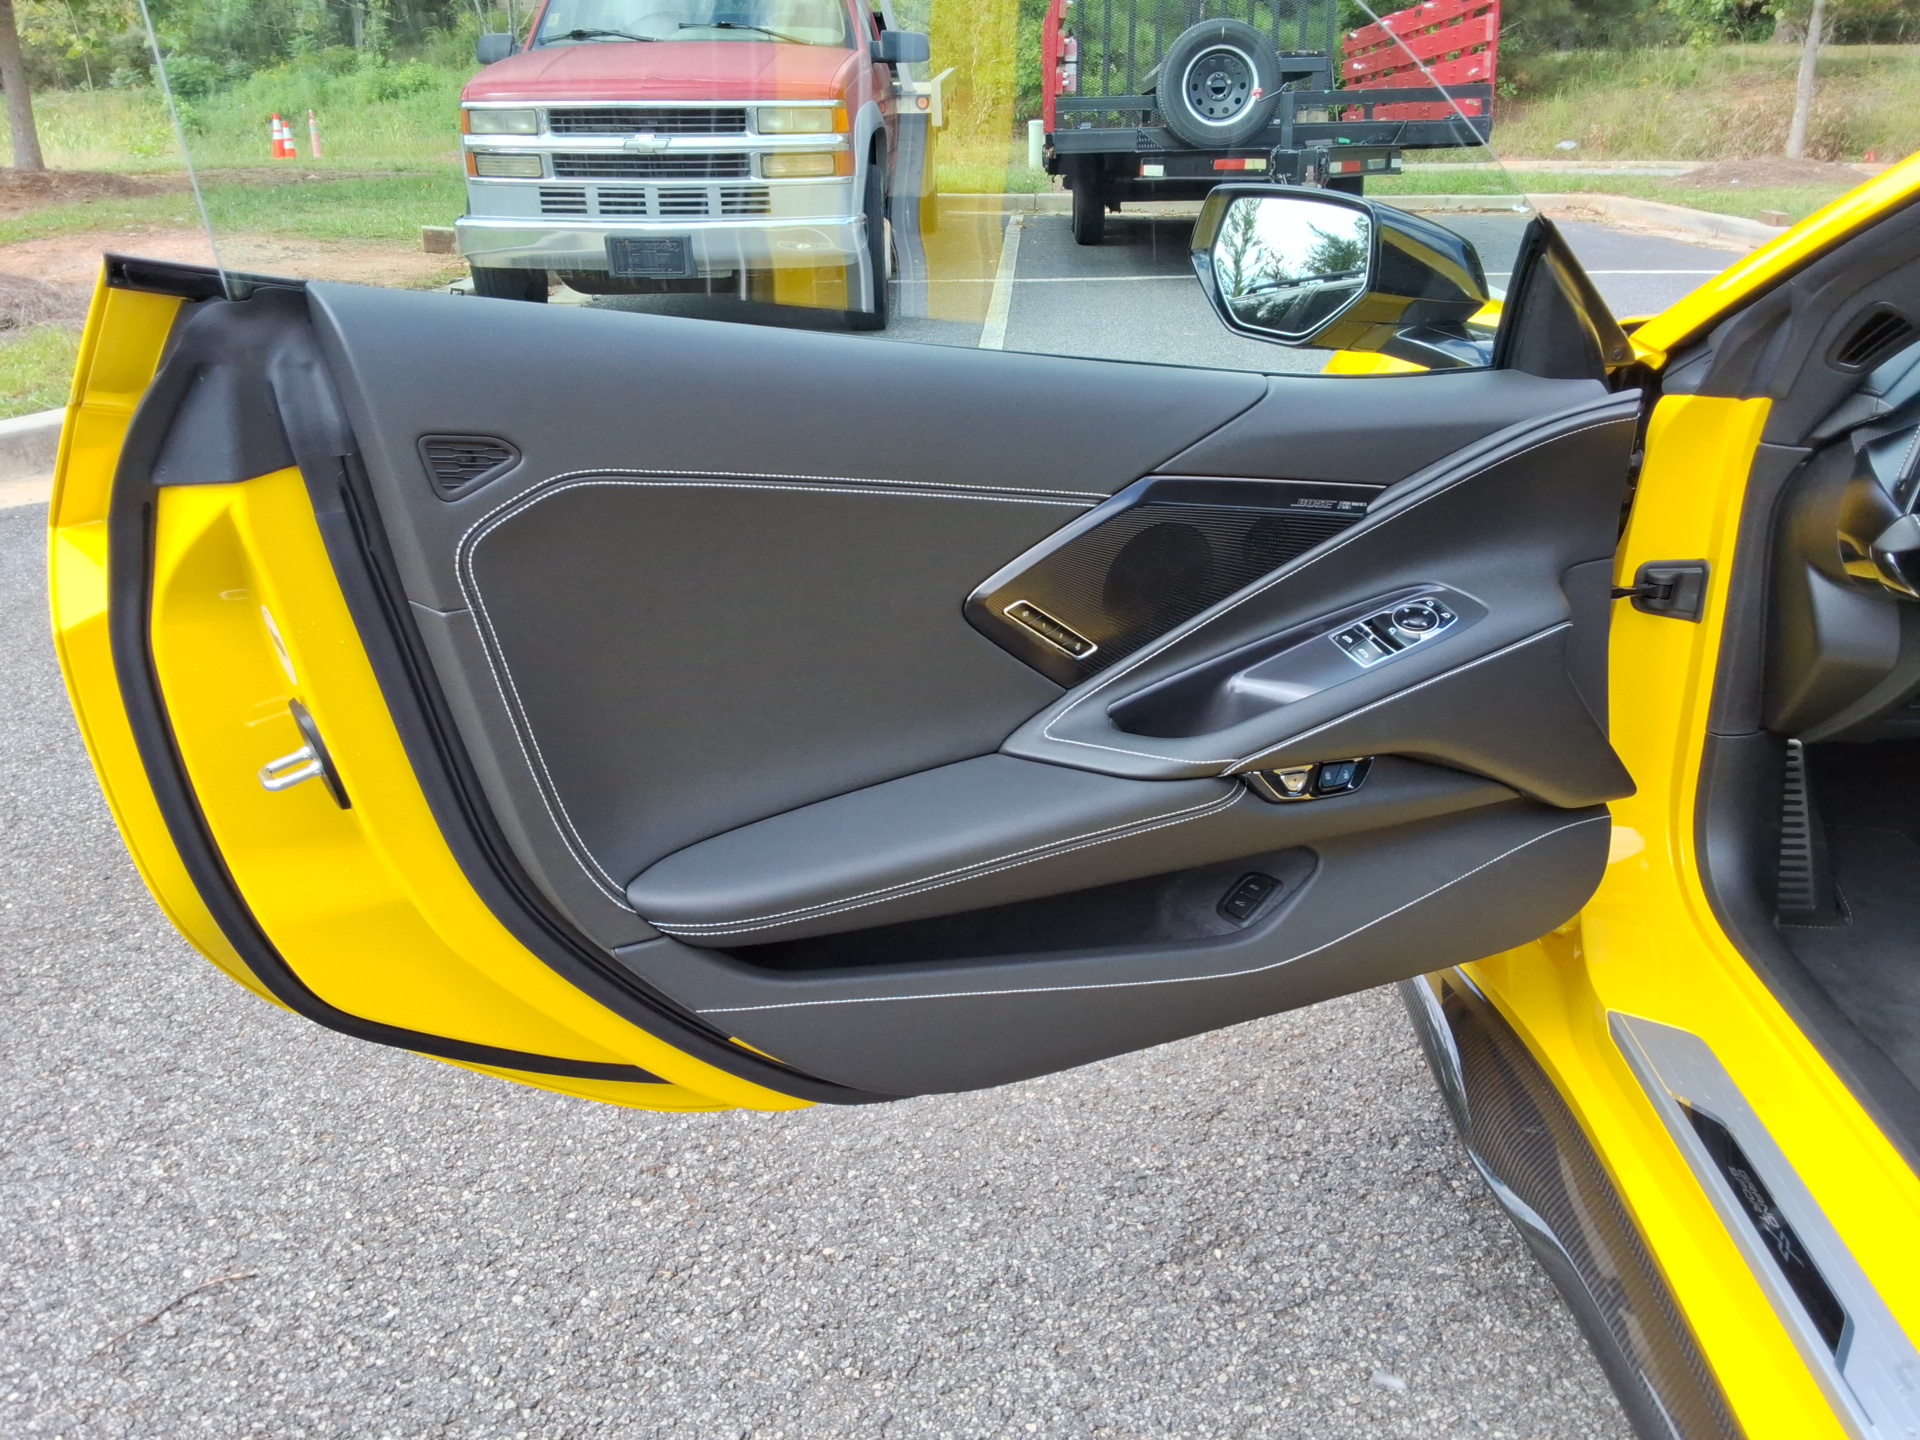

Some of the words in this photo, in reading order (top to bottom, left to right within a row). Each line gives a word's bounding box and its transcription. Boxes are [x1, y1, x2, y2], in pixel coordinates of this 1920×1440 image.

[1290, 498, 1337, 509] BOSE
[1728, 1165, 1771, 1226] SPORT
[1738, 1169, 1780, 1228] GRAND
